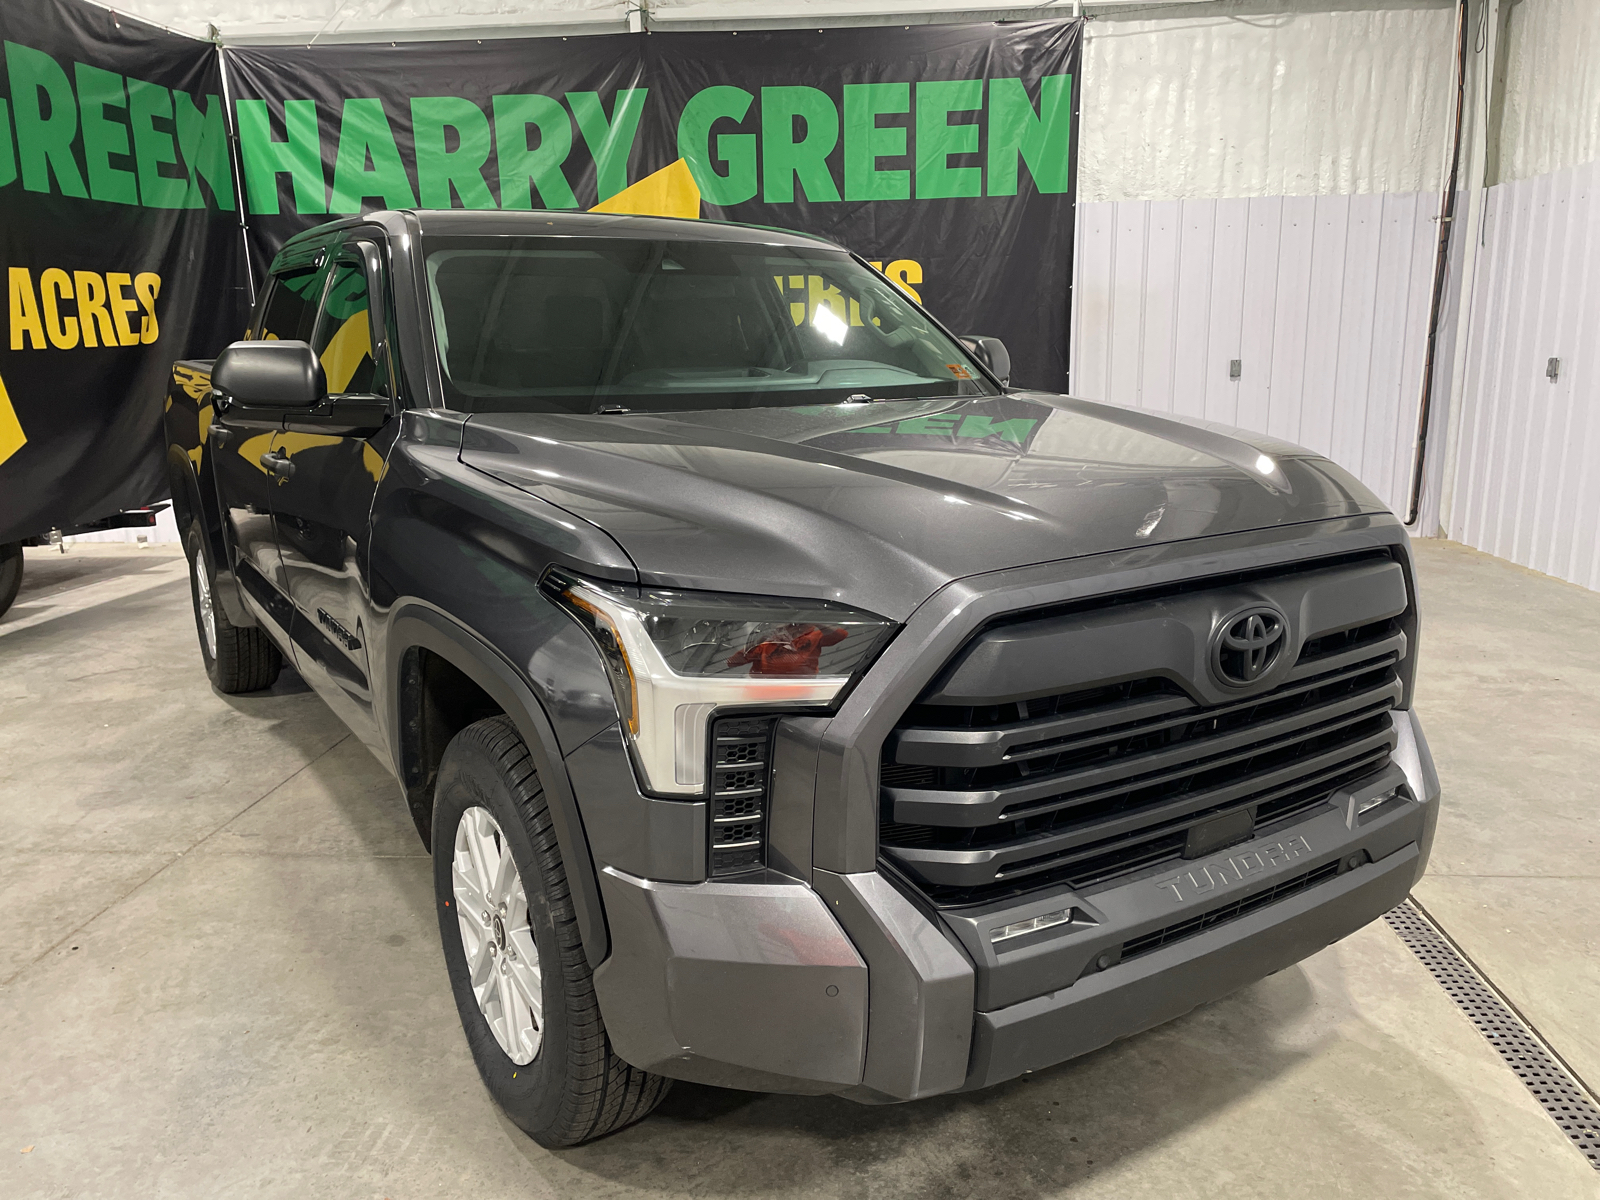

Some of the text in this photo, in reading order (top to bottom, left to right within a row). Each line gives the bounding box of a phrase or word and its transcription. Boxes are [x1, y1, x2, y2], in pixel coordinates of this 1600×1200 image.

[0, 40, 236, 212] REEN
[236, 73, 1073, 215] HARRY GREEN
[8, 266, 162, 351] ACRES
[1155, 834, 1313, 902] TUNDRA
